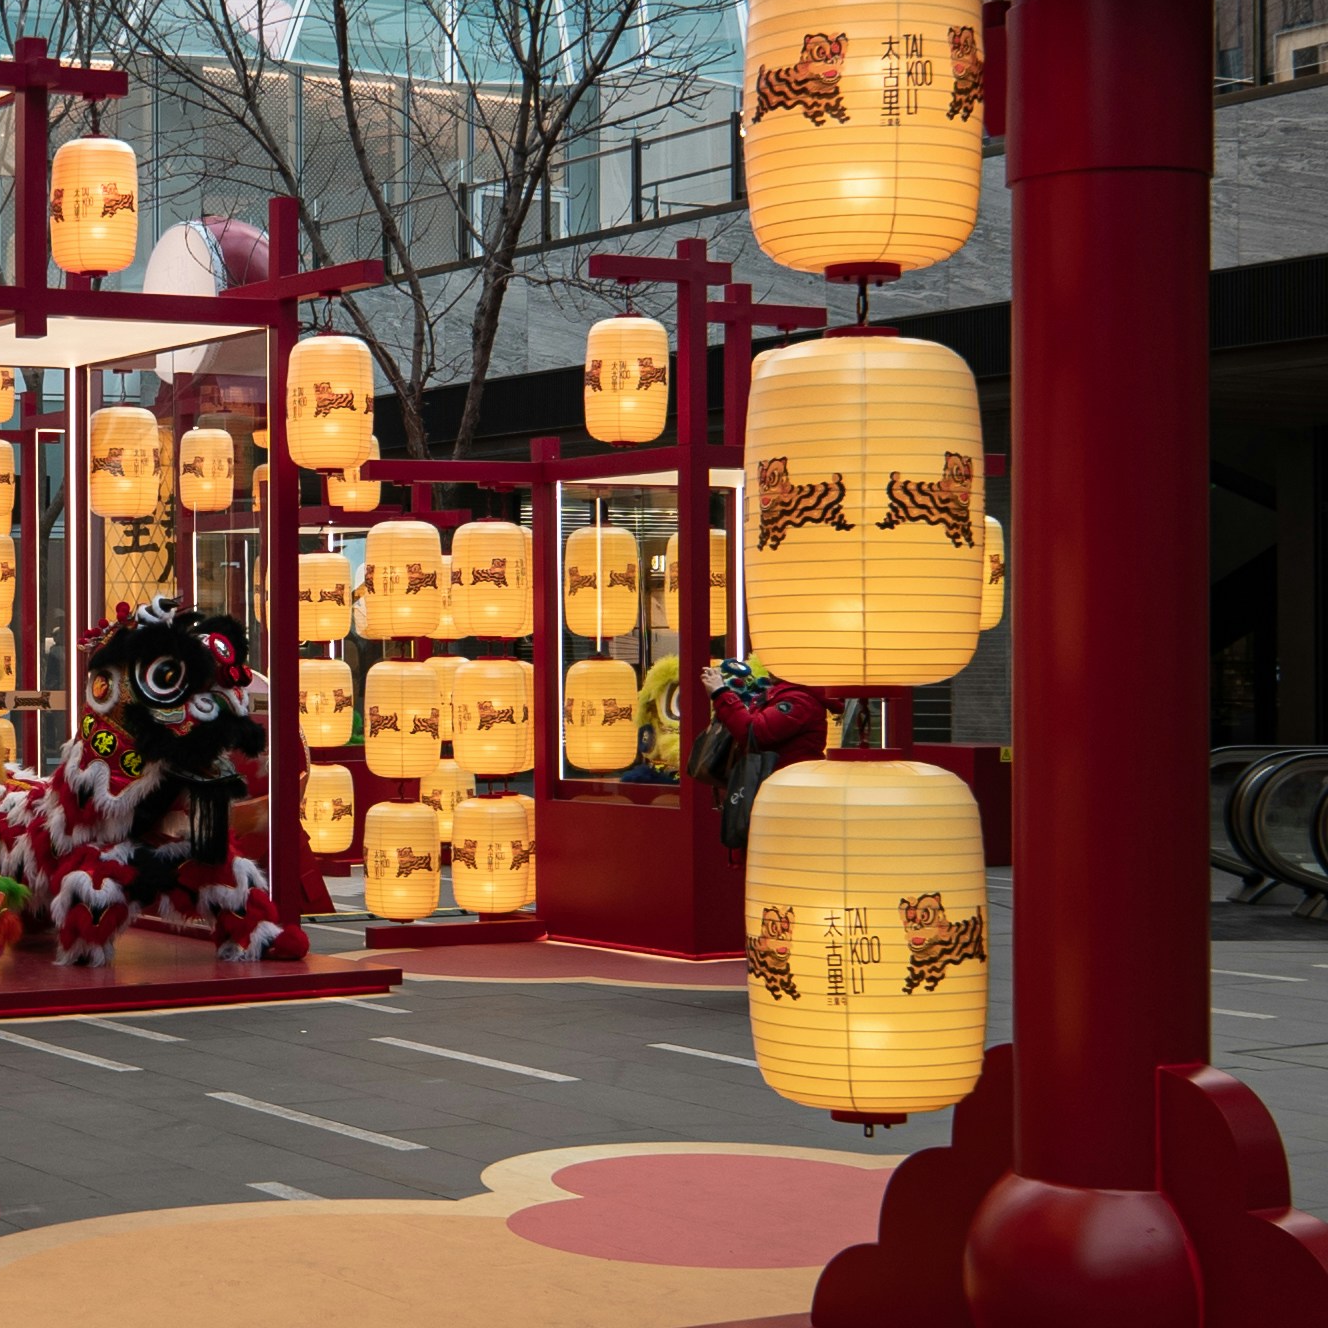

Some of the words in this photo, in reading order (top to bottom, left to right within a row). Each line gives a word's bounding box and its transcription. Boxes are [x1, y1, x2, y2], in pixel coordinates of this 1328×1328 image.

[903, 33, 922, 59] TAI
[881, 35, 900, 116] 太古里
[906, 59, 933, 87] KOO
[906, 88, 918, 115] LI
[845, 906, 868, 935] TAI
[824, 910, 846, 996] 太古里
[850, 936, 881, 965] KOO
[852, 967, 865, 994] LI
